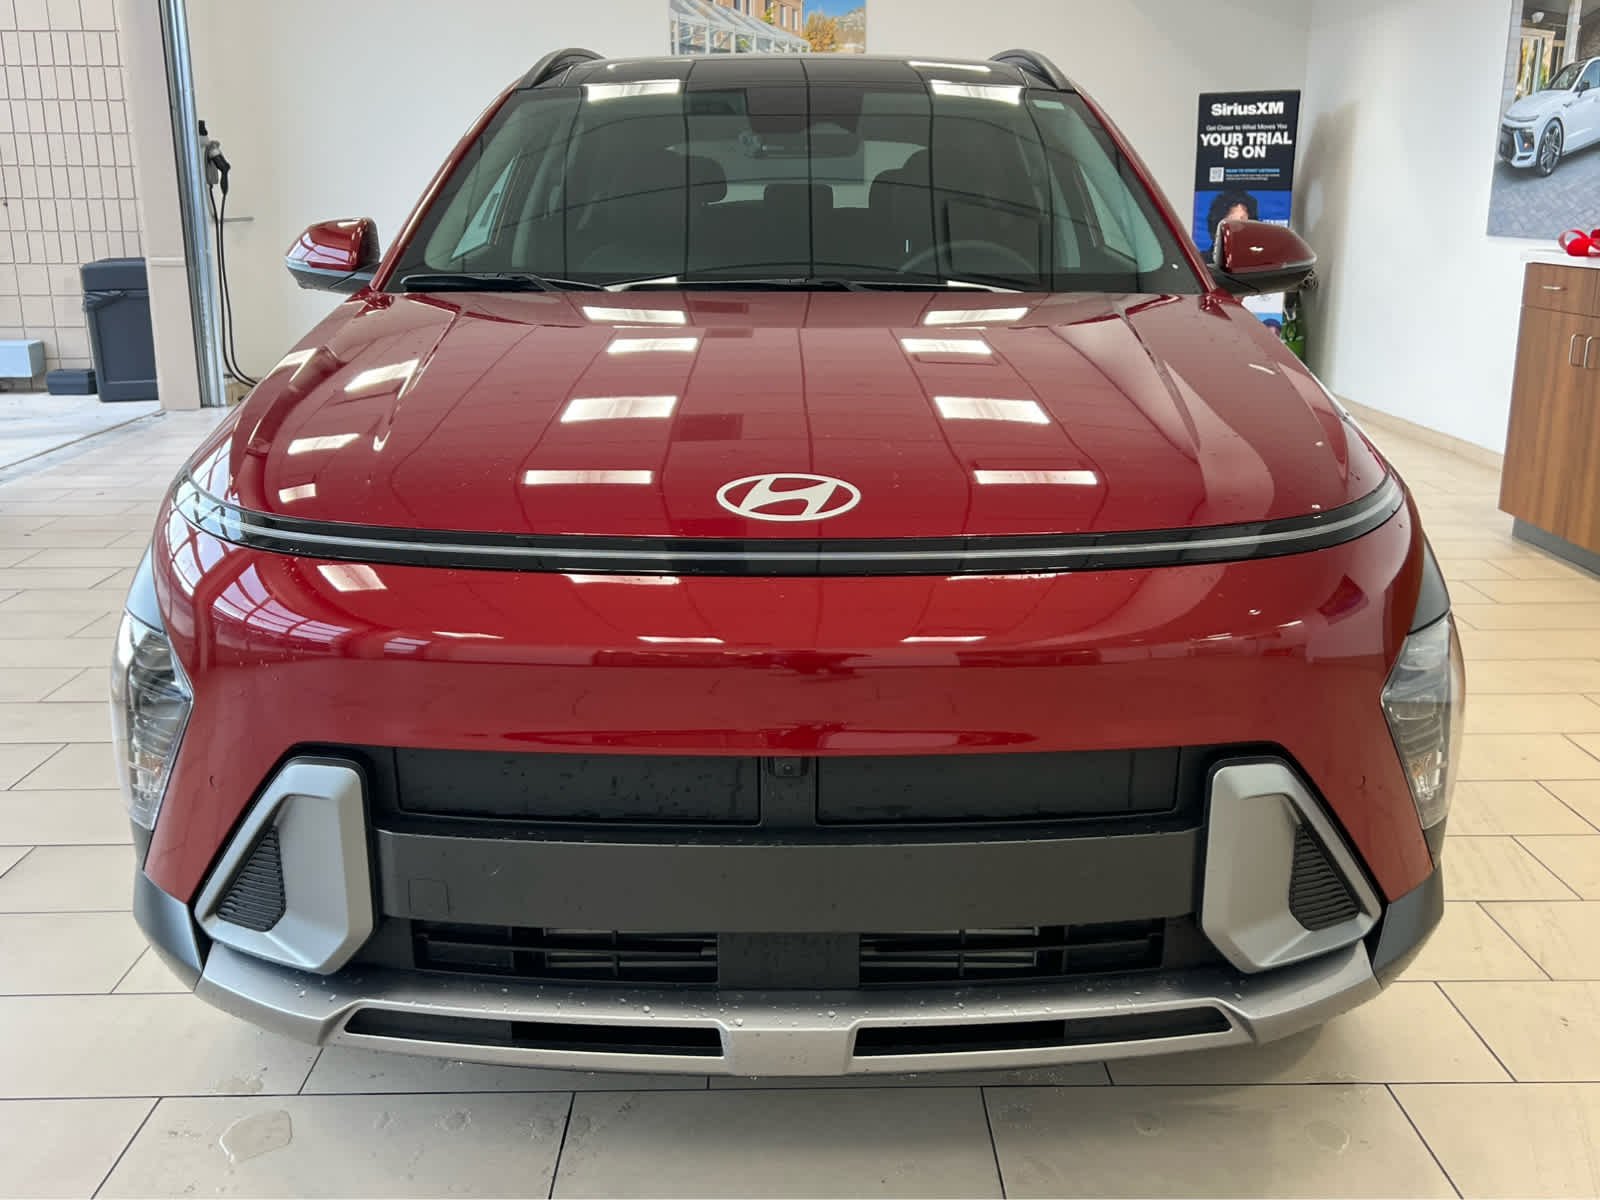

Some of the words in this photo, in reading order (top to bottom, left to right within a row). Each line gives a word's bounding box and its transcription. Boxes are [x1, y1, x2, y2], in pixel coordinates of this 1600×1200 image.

[1211, 101, 1284, 116] SiriusXM
[1200, 133, 1243, 146] YOUR
[1246, 131, 1292, 145] TRIAL
[1223, 146, 1239, 158] IS
[1242, 145, 1266, 158] ON
